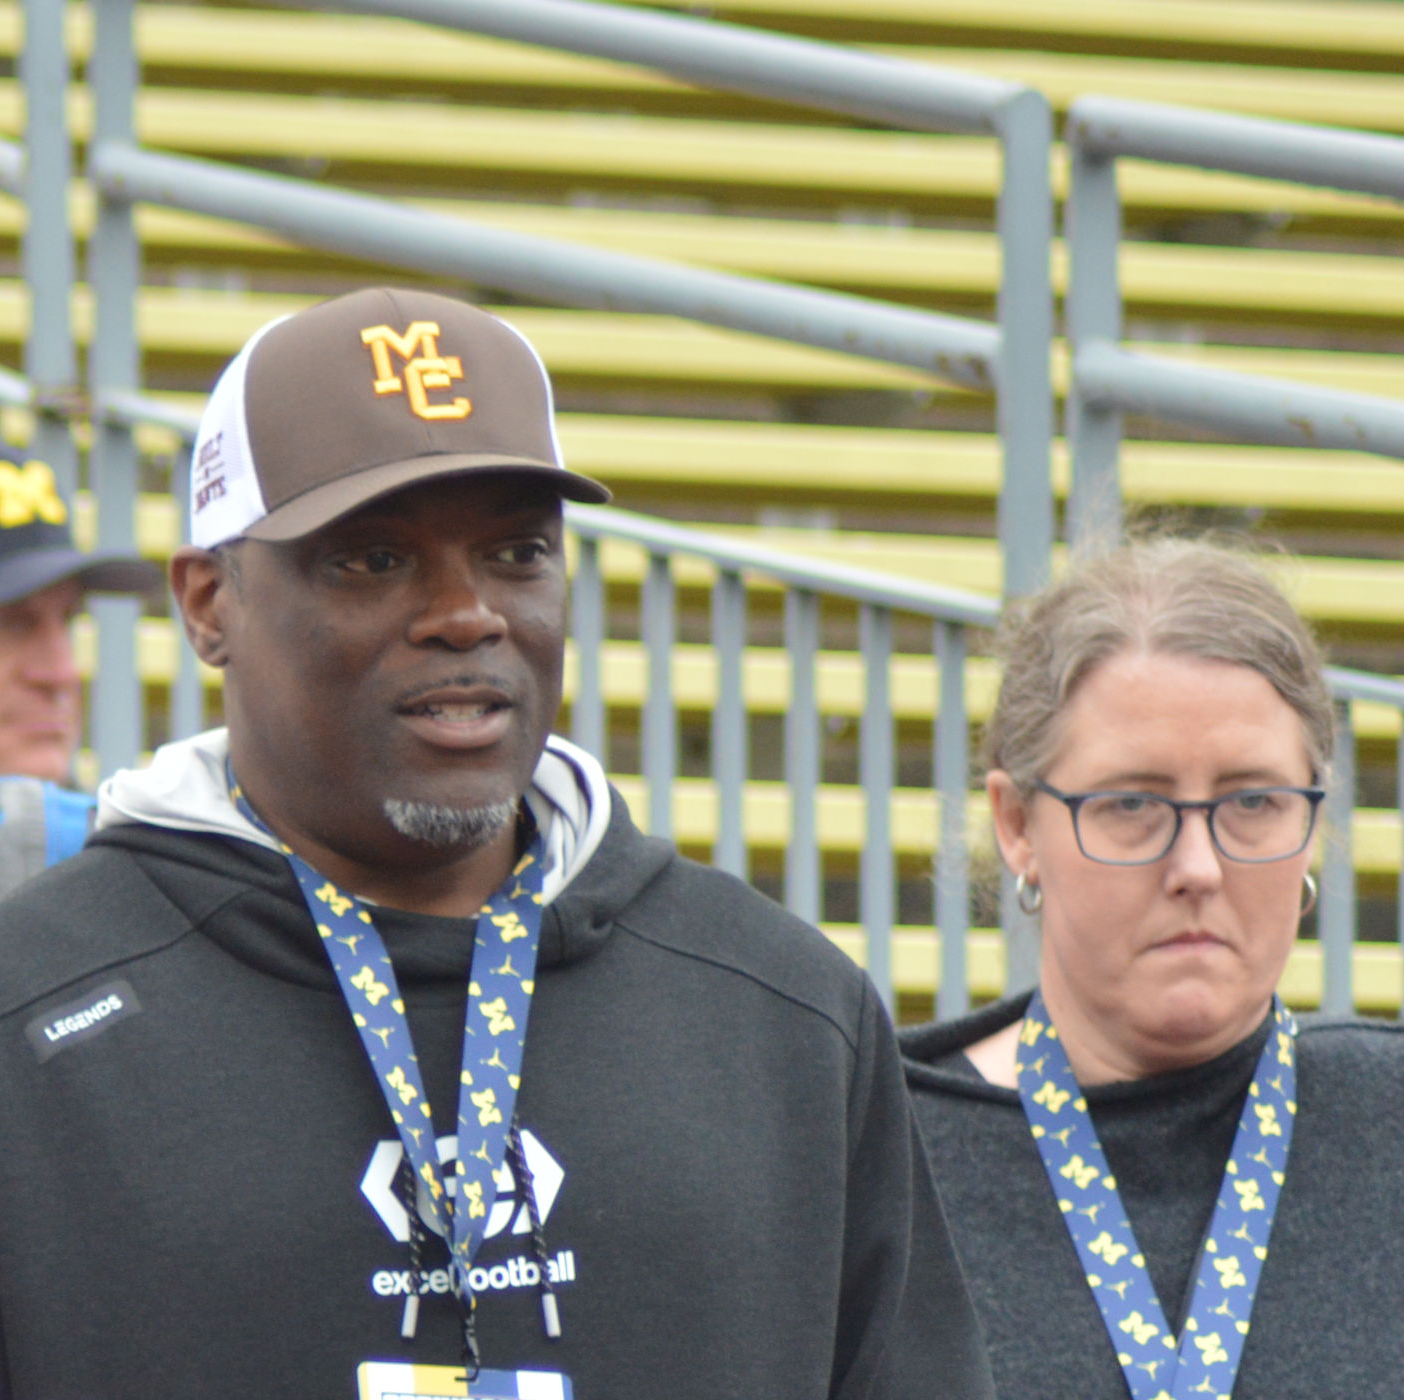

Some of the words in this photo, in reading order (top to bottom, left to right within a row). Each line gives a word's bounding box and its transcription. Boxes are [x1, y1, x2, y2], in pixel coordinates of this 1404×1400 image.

[360, 320, 472, 421] MC
[44, 994, 123, 1042] LEGENDS
[372, 1250, 576, 1297] excelootball
